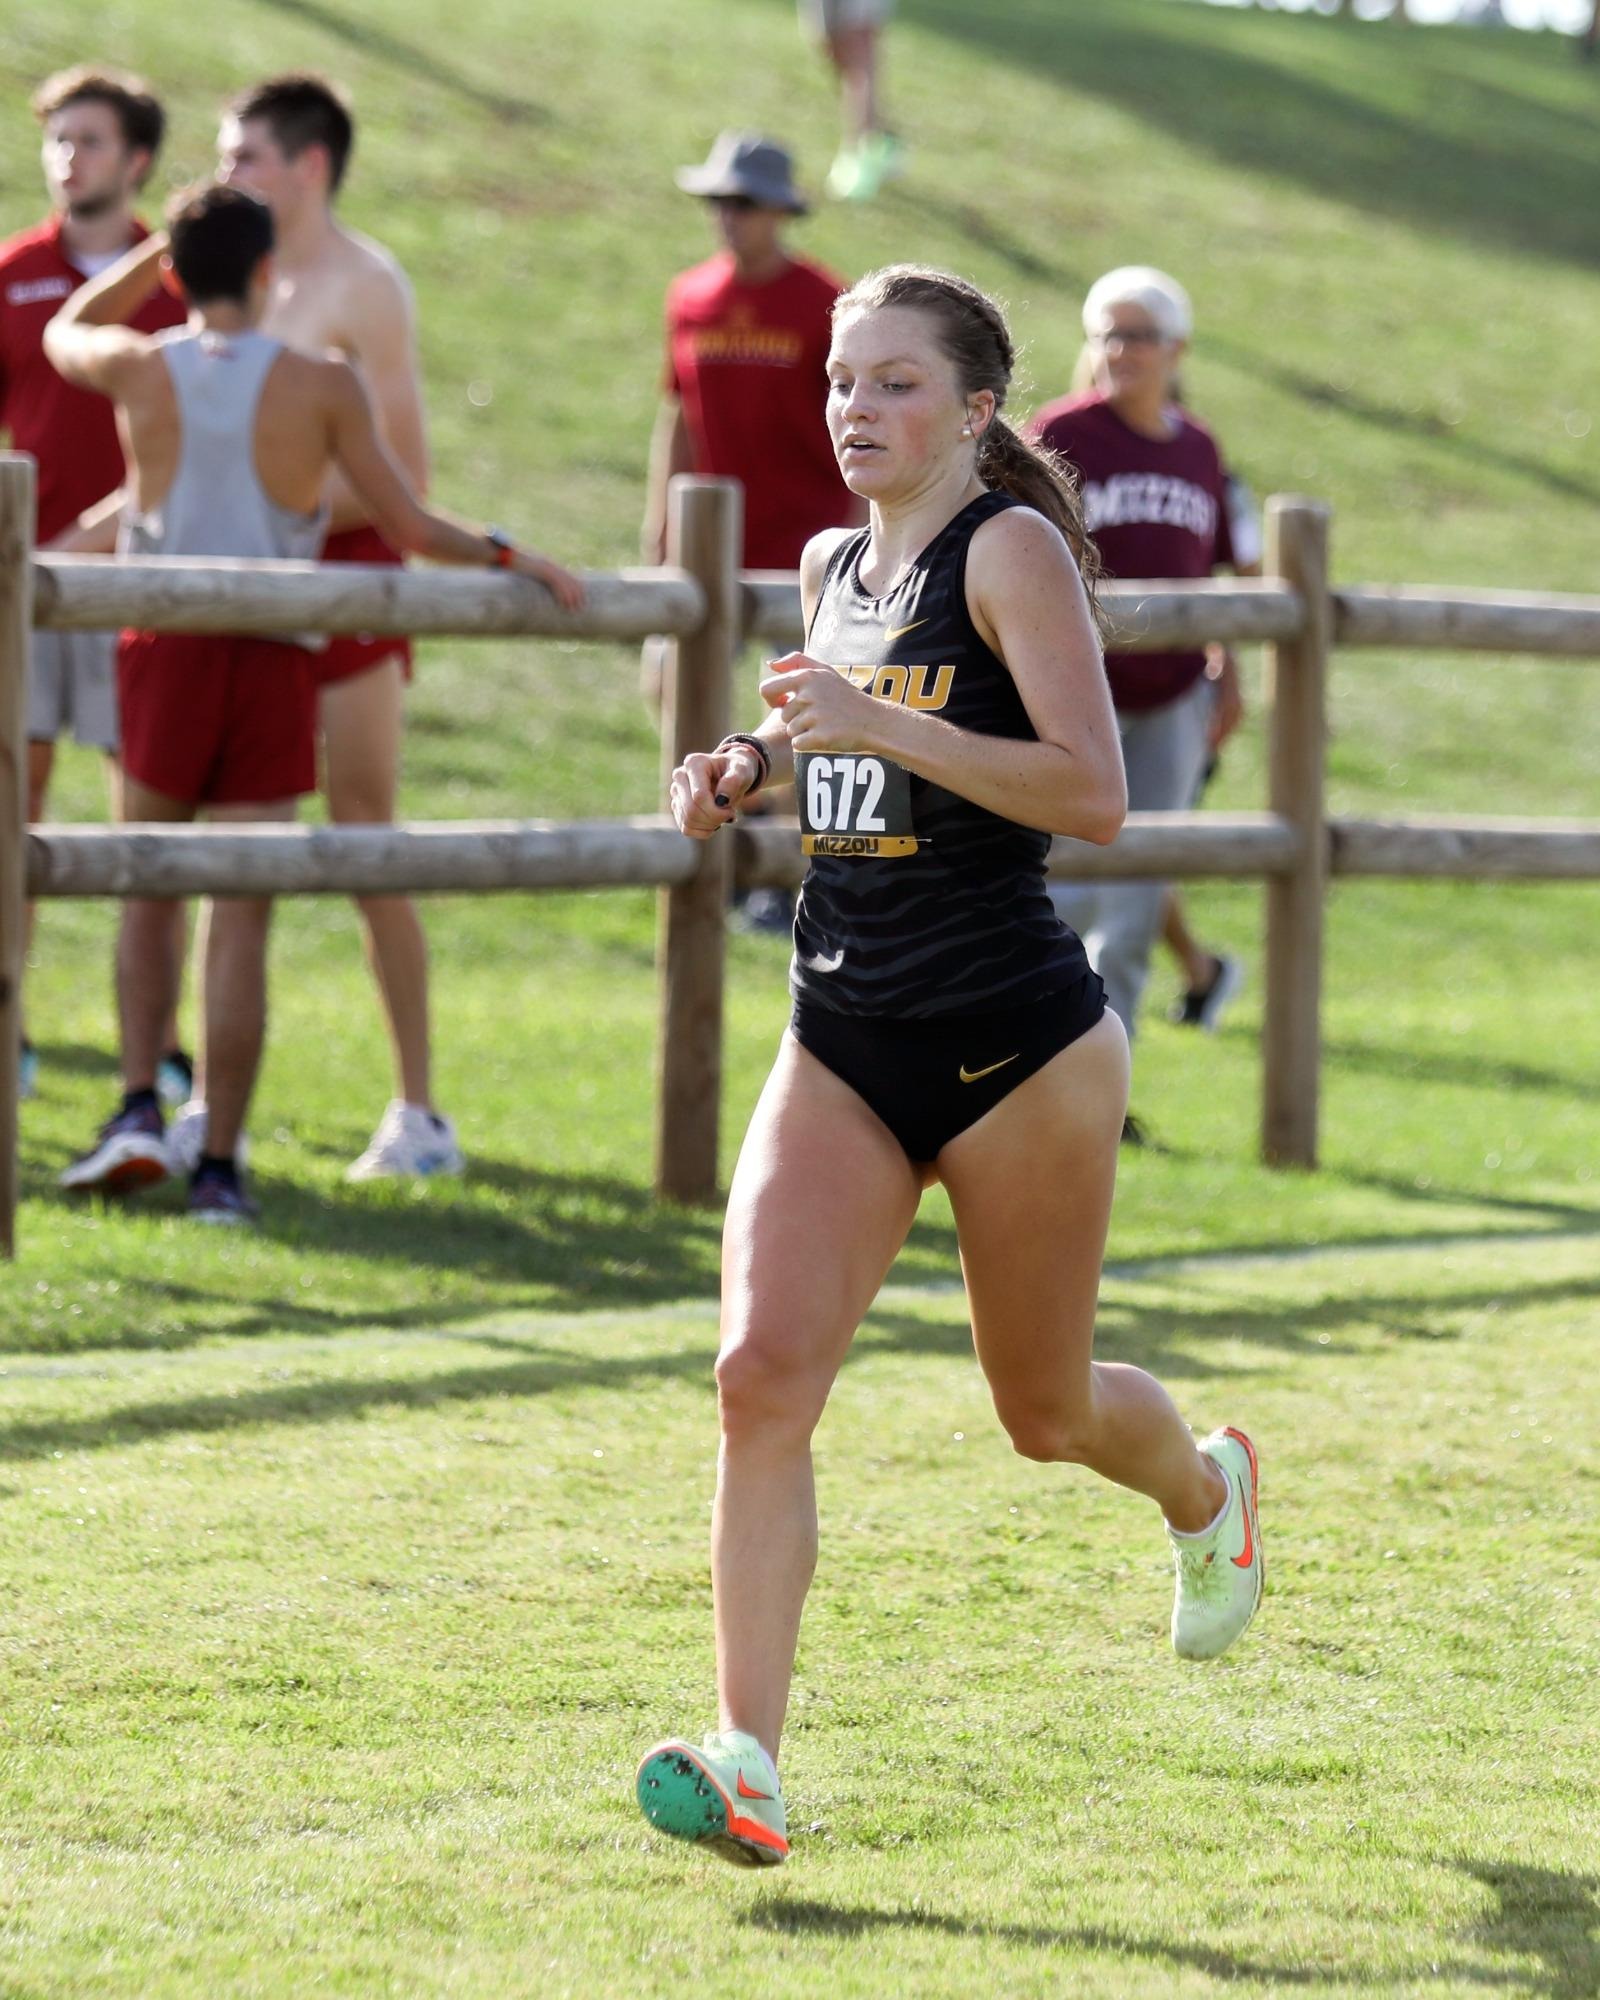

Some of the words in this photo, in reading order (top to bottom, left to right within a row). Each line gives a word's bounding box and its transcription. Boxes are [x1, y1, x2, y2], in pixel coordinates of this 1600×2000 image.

[831, 665, 956, 711] ZOU
[806, 756, 886, 832] 672
[813, 836, 879, 855] MIZZOU
